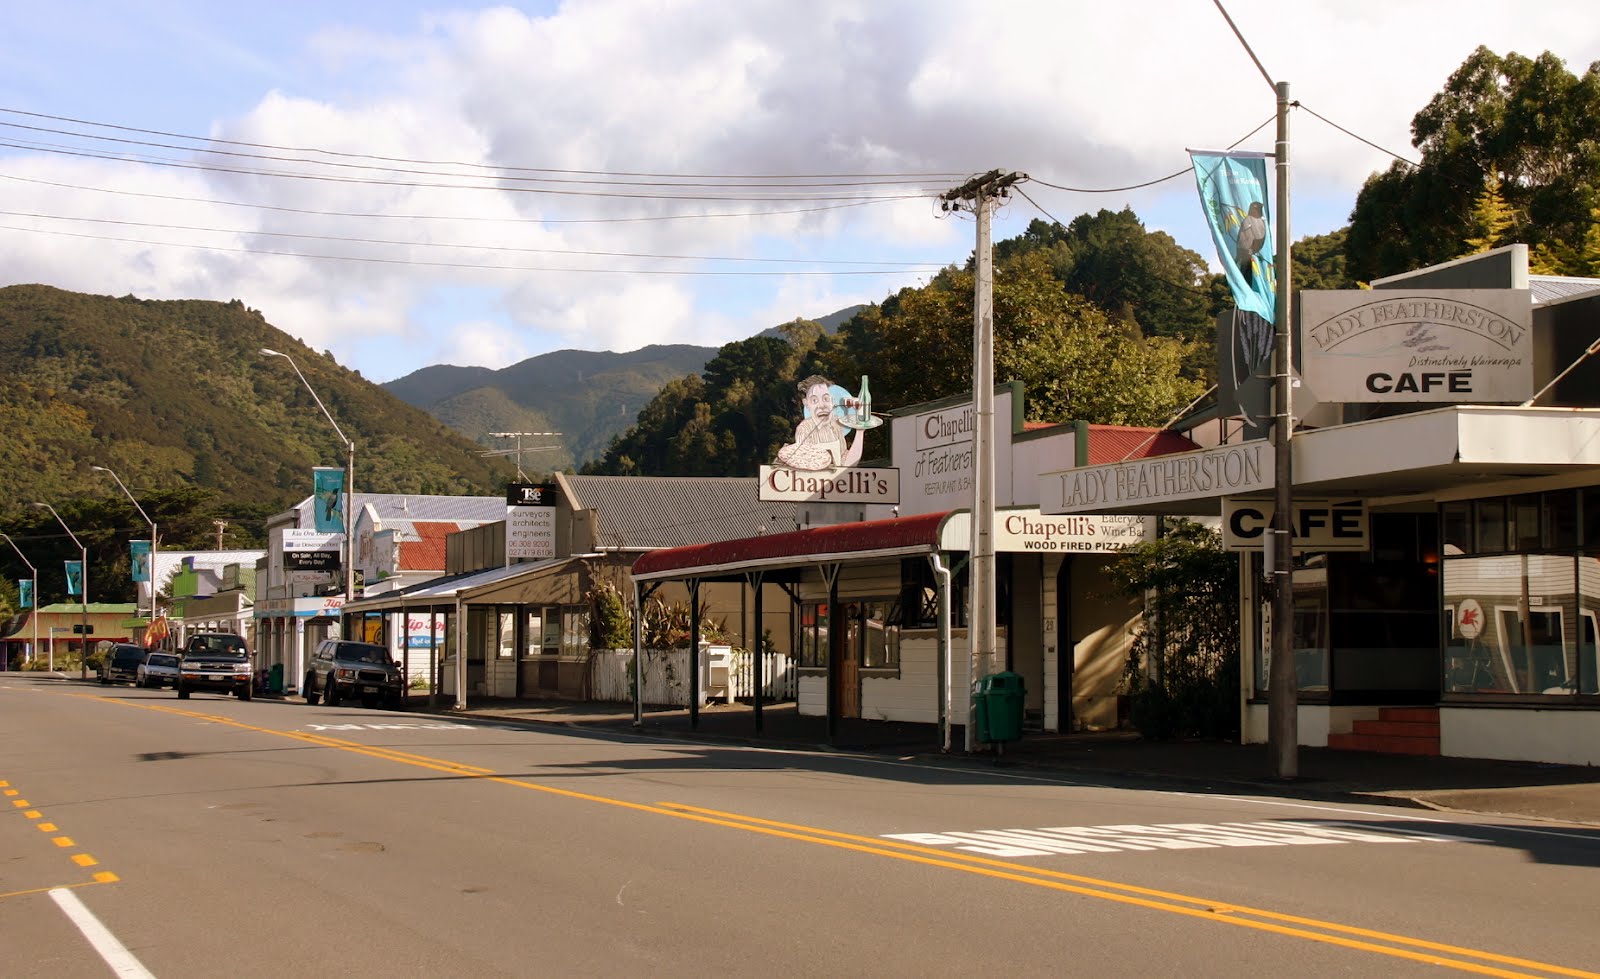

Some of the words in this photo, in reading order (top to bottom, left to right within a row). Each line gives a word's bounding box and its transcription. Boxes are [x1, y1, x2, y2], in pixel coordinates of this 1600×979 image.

[1312, 311, 1364, 348] LADY
[1371, 302, 1524, 347] FEATHERSTON
[1408, 355, 1468, 368] Distinctively
[1470, 355, 1522, 370] Wairarapa
[924, 408, 973, 441] Chapelli
[914, 452, 926, 478] of
[928, 447, 973, 475] Featherst
[768, 468, 888, 500] Chapelli's
[1060, 468, 1110, 508] LADY
[1114, 446, 1263, 501] FEATHERSTON
[521, 487, 541, 501] Tse
[925, 480, 956, 495] RESTAURANT
[512, 511, 551, 519] surveyors
[1101, 514, 1132, 526] Eatery
[1135, 514, 1145, 524] &
[1229, 500, 1364, 538] CFÉ
[512, 530, 551, 539] engineers
[1004, 515, 1096, 540] Chapelli's
[1100, 525, 1126, 537] Wine
[1129, 526, 1146, 537] Bar
[1024, 541, 1057, 550] WOOD
[1060, 541, 1092, 550] FIRED
[324, 599, 341, 608] Tip
